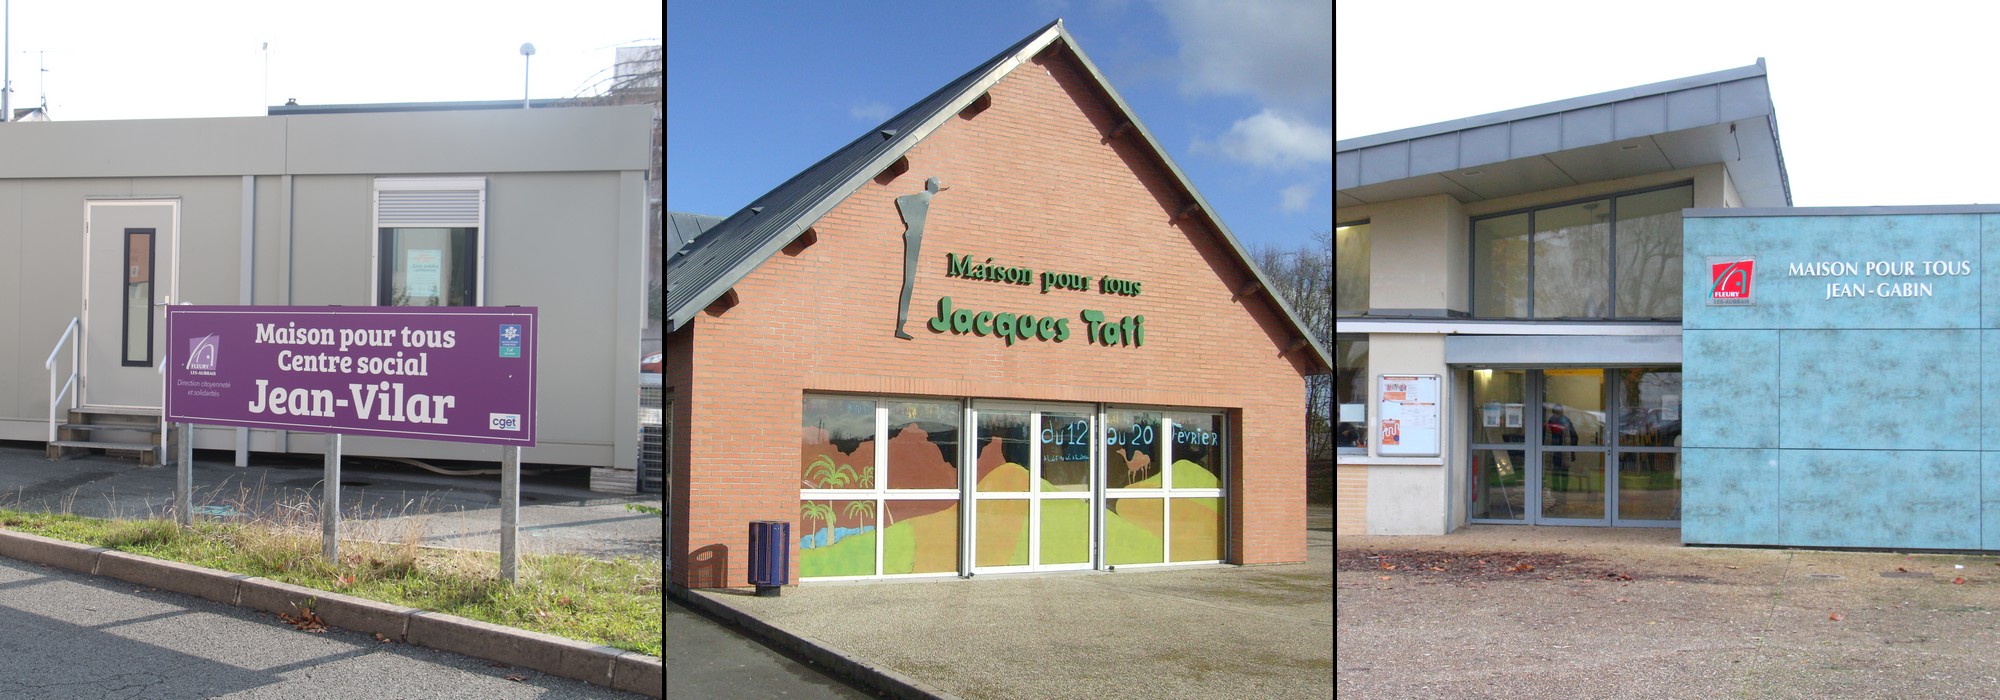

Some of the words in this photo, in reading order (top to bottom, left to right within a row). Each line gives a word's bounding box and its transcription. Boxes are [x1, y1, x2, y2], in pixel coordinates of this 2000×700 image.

[946, 252, 1034, 285] Maison
[1040, 269, 1093, 294] pour
[1099, 275, 1142, 297] tous
[1788, 261, 1858, 276] MAISON
[1865, 261, 1915, 276] POUR
[1923, 260, 1971, 276] TOUS
[927, 295, 1070, 347] Jacques
[1080, 309, 1145, 349] Tati
[255, 322, 335, 346] Maison
[340, 325, 396, 351] pour
[401, 327, 456, 349] tous
[278, 350, 352, 373] Centre
[357, 352, 428, 376] social
[177, 379, 200, 387] Direction
[248, 379, 455, 424] Jean-Vilar
[492, 418, 516, 429] cget
[1041, 420, 1064, 445] du
[1067, 420, 1089, 445] 12
[1106, 427, 1126, 446] au
[1131, 423, 1153, 445] 20
